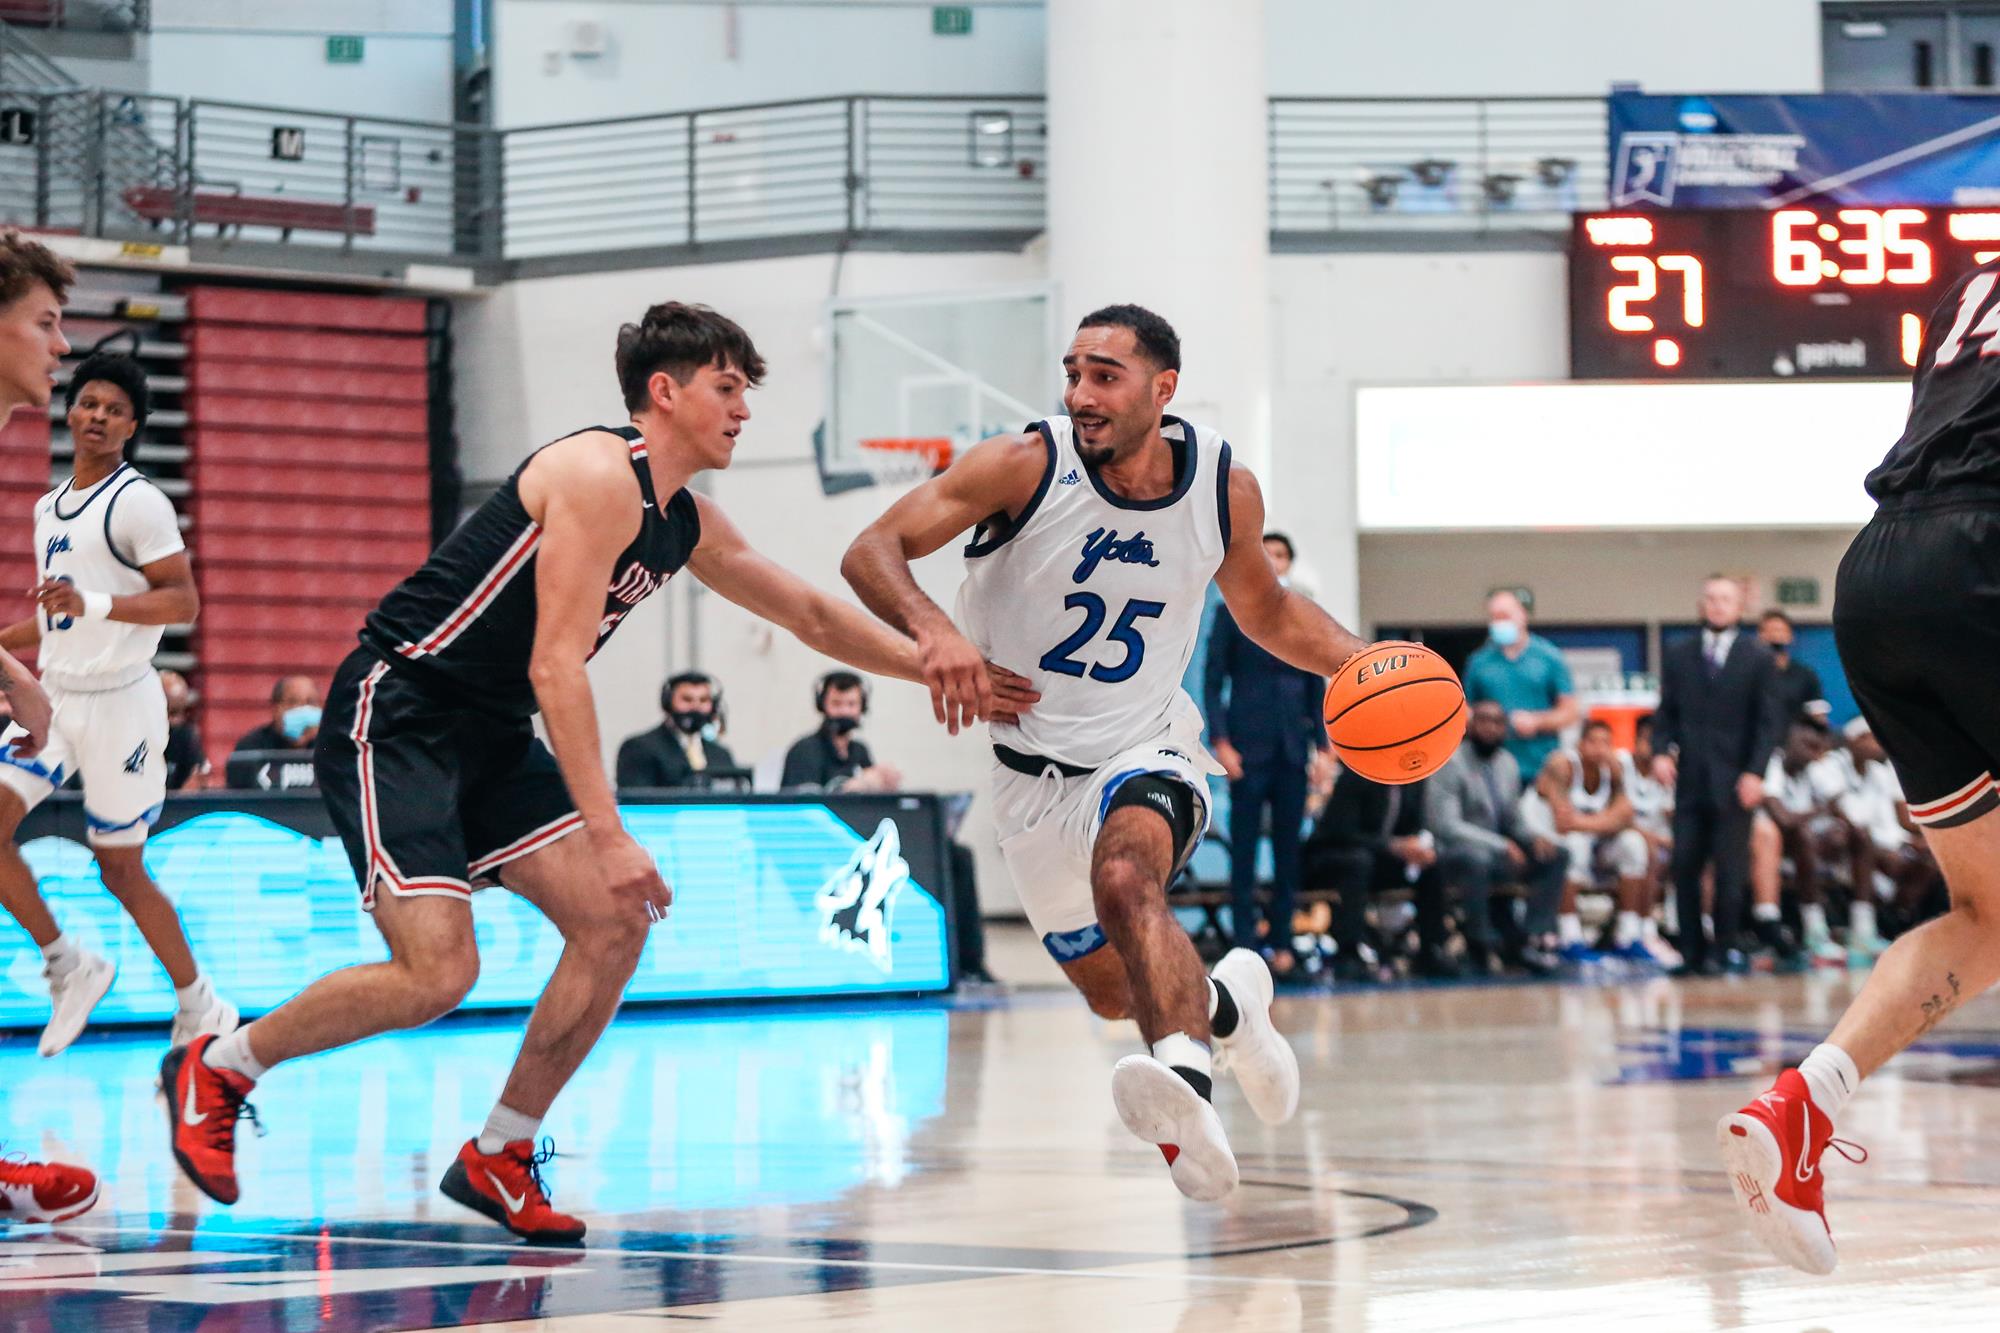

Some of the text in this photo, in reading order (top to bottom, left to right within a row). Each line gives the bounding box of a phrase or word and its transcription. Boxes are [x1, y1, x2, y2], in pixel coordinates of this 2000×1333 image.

[10, 111, 29, 142] L
[1773, 209, 1932, 285] 6:35
[1608, 255, 1703, 331] 27
[1072, 527, 1160, 584] Yotes
[1039, 591, 1167, 683] 25
[1358, 655, 1407, 685] EVO
